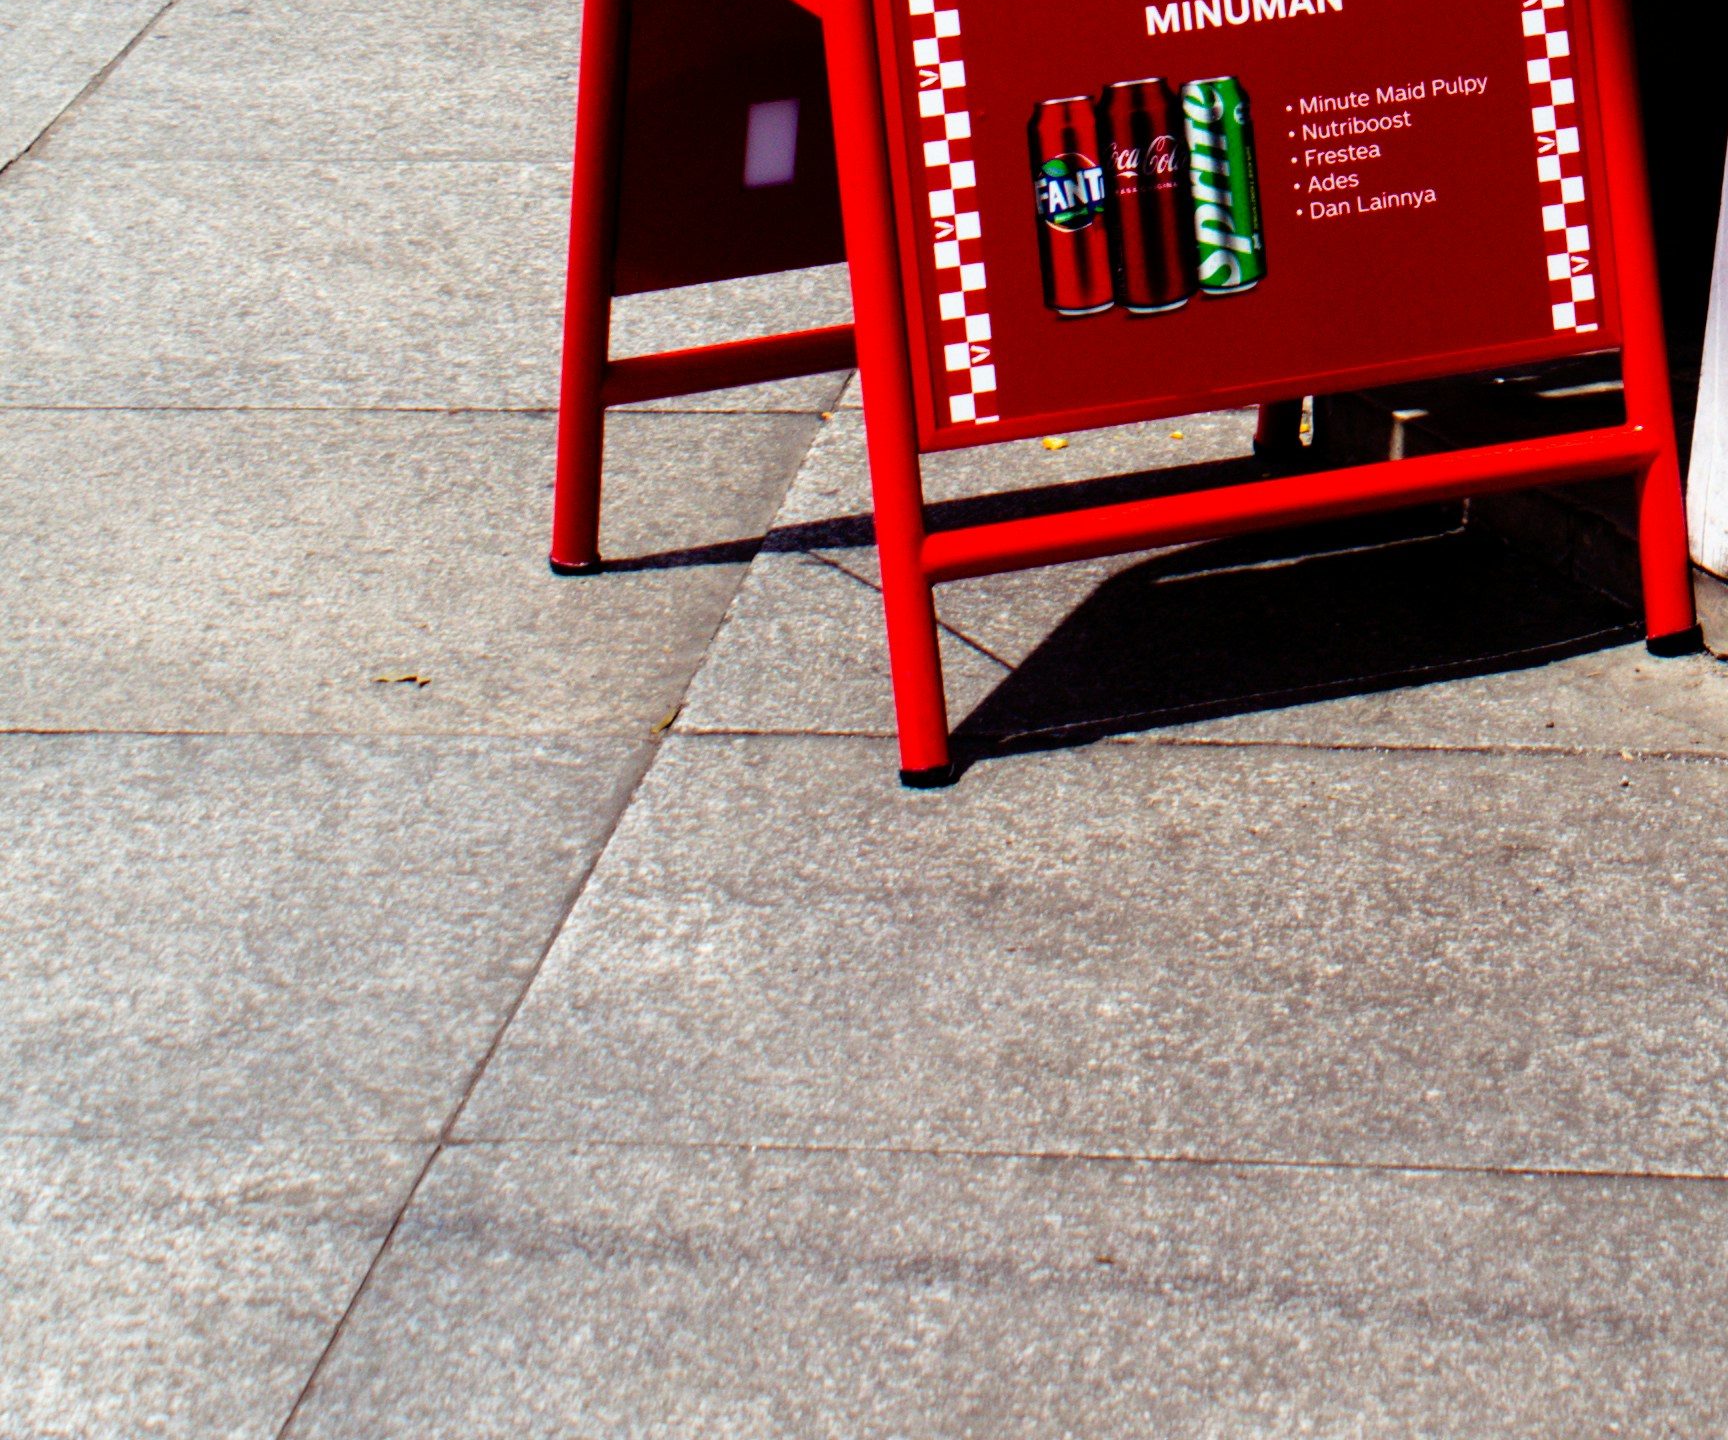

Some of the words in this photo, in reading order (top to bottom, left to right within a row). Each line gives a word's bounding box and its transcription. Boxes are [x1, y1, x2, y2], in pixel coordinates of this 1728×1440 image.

[1300, 92, 1369, 114] Minute
[1376, 82, 1425, 104] Maid
[1432, 76, 1487, 96] Pulpy
[1302, 111, 1411, 140] Nutriboost
[1305, 145, 1381, 167] Frestea
[1035, 166, 1106, 215] FANT
[1308, 173, 1359, 193] Ades
[1310, 201, 1350, 219] Dan
[1357, 189, 1436, 212] Lainnya
